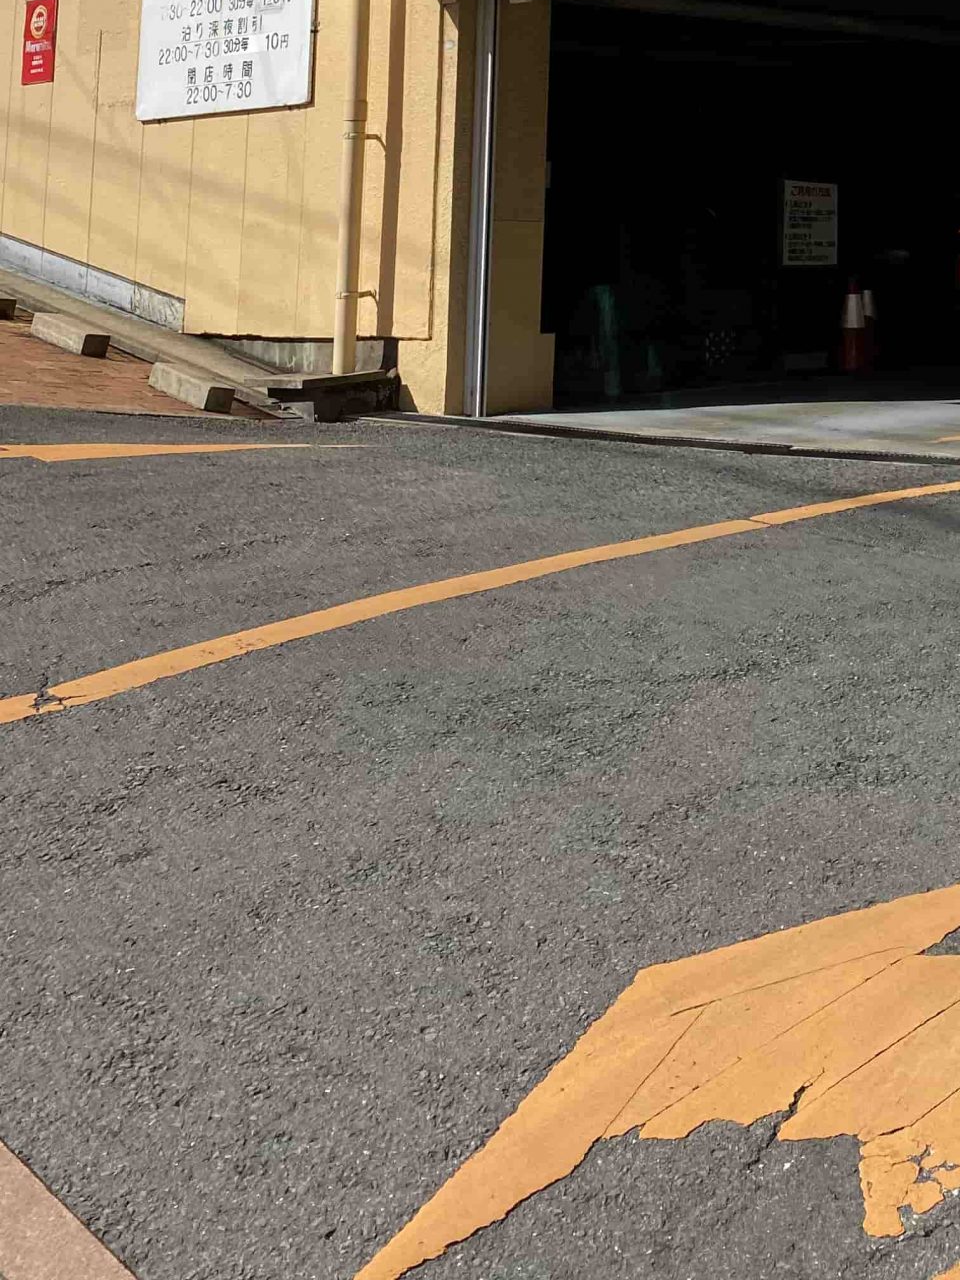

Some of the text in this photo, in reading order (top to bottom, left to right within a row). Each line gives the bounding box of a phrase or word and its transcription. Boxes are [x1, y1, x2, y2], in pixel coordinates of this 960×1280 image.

[181, 15, 263, 42] 泊り深夜割引
[265, 32, 289, 52] 10円
